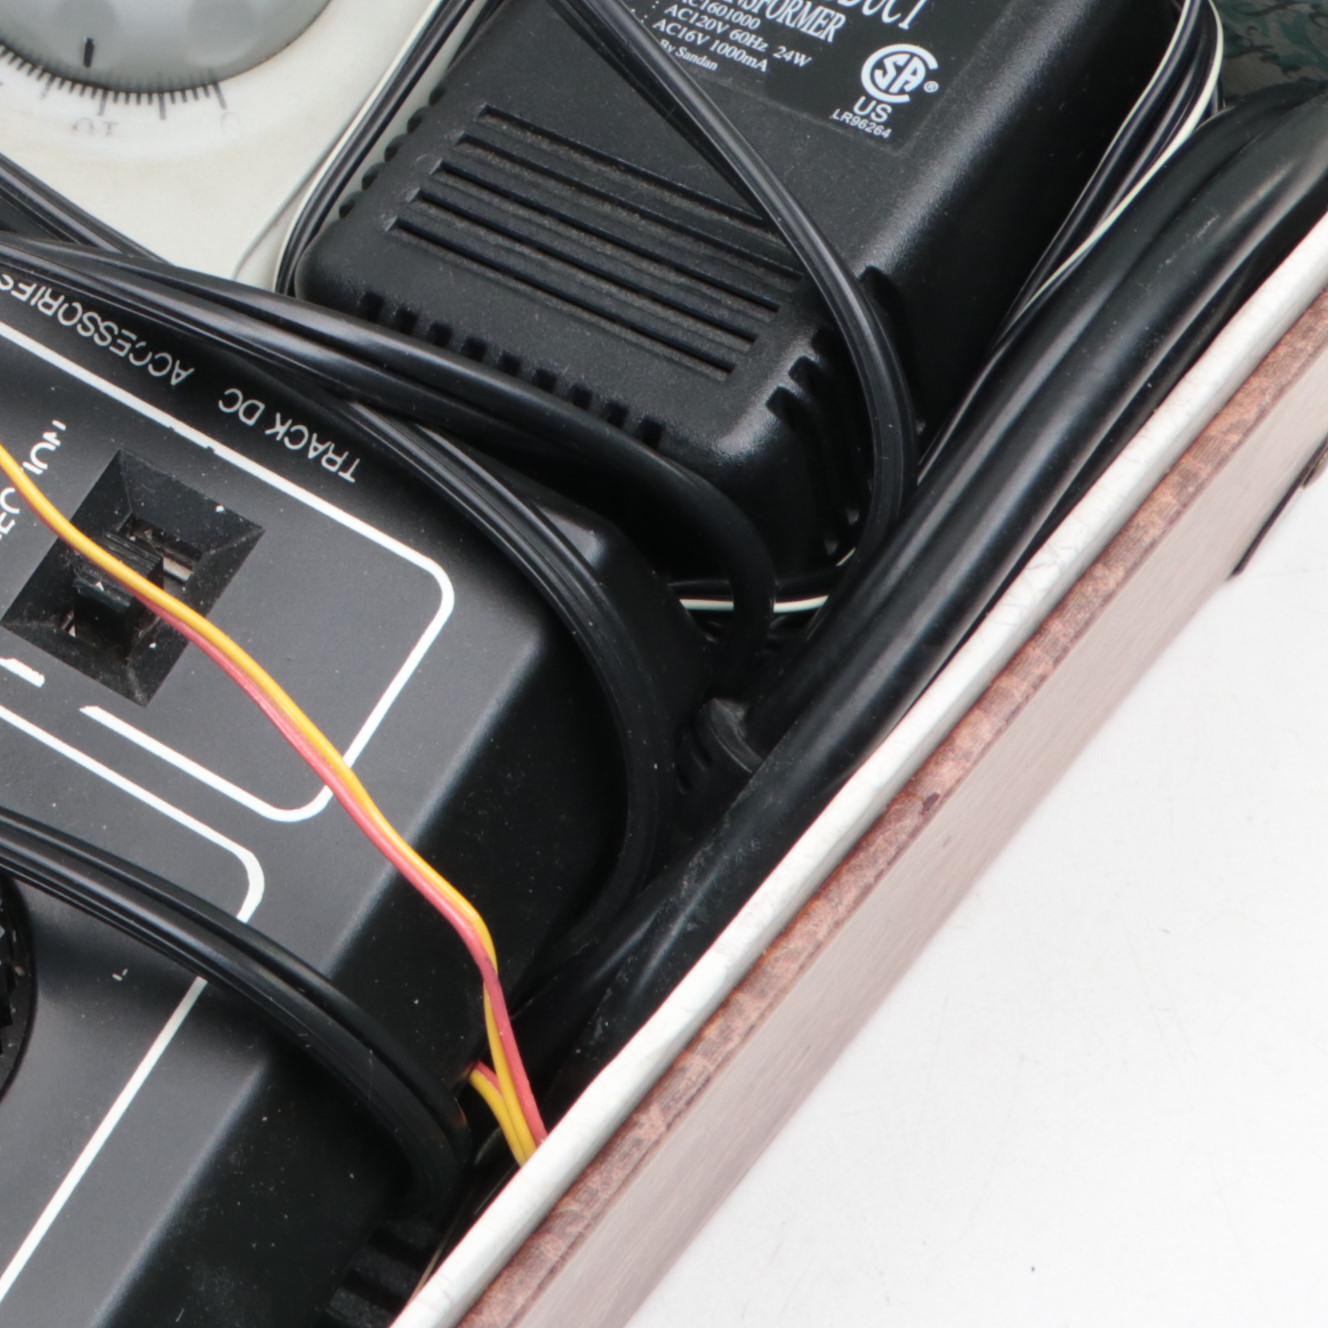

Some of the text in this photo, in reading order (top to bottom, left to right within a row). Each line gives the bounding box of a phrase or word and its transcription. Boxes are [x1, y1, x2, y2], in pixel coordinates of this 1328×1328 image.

[652, 18, 770, 74] AC16V 1000mA
[664, 3, 730, 37] AC120V
[729, 27, 770, 54] 60Hz
[772, 45, 813, 69] 24W
[830, 108, 894, 140] LR96264
[852, 96, 894, 124] US
[217, 387, 362, 484] TRACK DC
